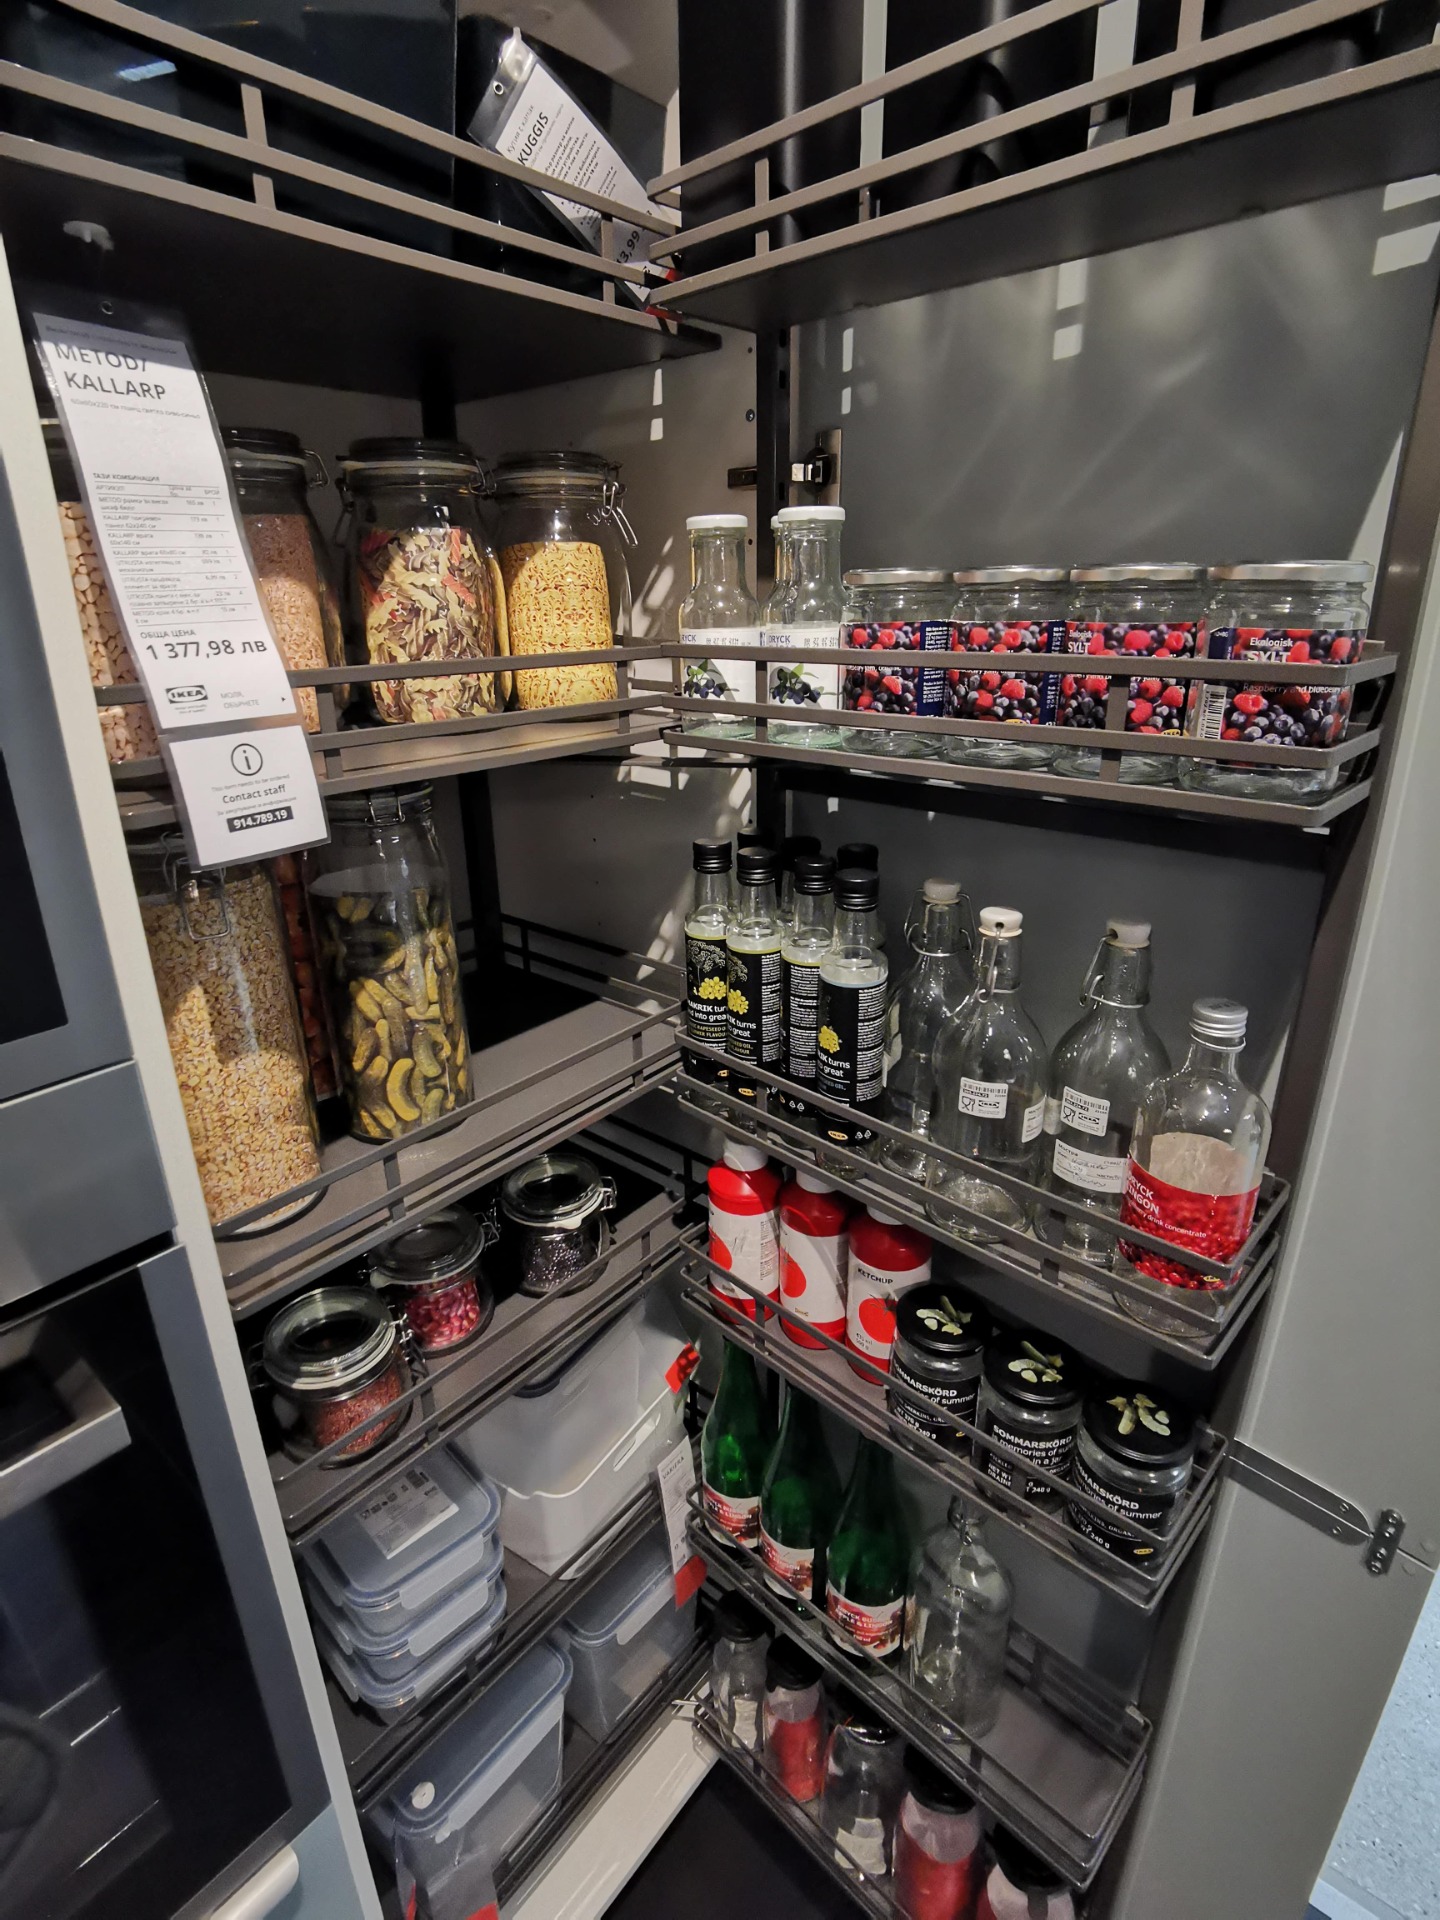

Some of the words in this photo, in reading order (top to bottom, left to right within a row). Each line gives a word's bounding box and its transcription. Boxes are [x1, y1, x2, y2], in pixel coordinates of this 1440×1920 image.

[517, 112, 549, 166] KUGGIS
[63, 370, 167, 400] KALLARP
[140, 631, 170, 639] ОБЩА
[171, 629, 197, 638] ЦЕНА
[682, 634, 697, 642] RYCK
[146, 644, 158, 660] 1
[164, 639, 235, 659] 377,98
[241, 640, 268, 653] лв
[1067, 641, 1091, 653] SYLT
[1248, 650, 1293, 663] SYLT
[170, 688, 205, 700] IKEA
[1243, 683, 1287, 695] Raspberry
[222, 789, 262, 804] Contact
[263, 783, 286, 797] staff
[233, 809, 288, 829] 914.789.19
[736, 1020, 757, 1030] turns
[732, 1026, 751, 1038] great
[828, 1056, 851, 1069] turns
[823, 1064, 844, 1078] great
[1147, 1214, 1164, 1228] drink
[1164, 1222, 1208, 1238] concentrate
[857, 1267, 894, 1284] KETCHUP
[930, 1395, 940, 1405] of
[941, 1392, 976, 1405] summer
[993, 1424, 1073, 1449] SOMMARSKÖRD
[1047, 1447, 1058, 1457] of
[1119, 1507, 1163, 1520] summer
[1090, 1532, 1104, 1544] 240
